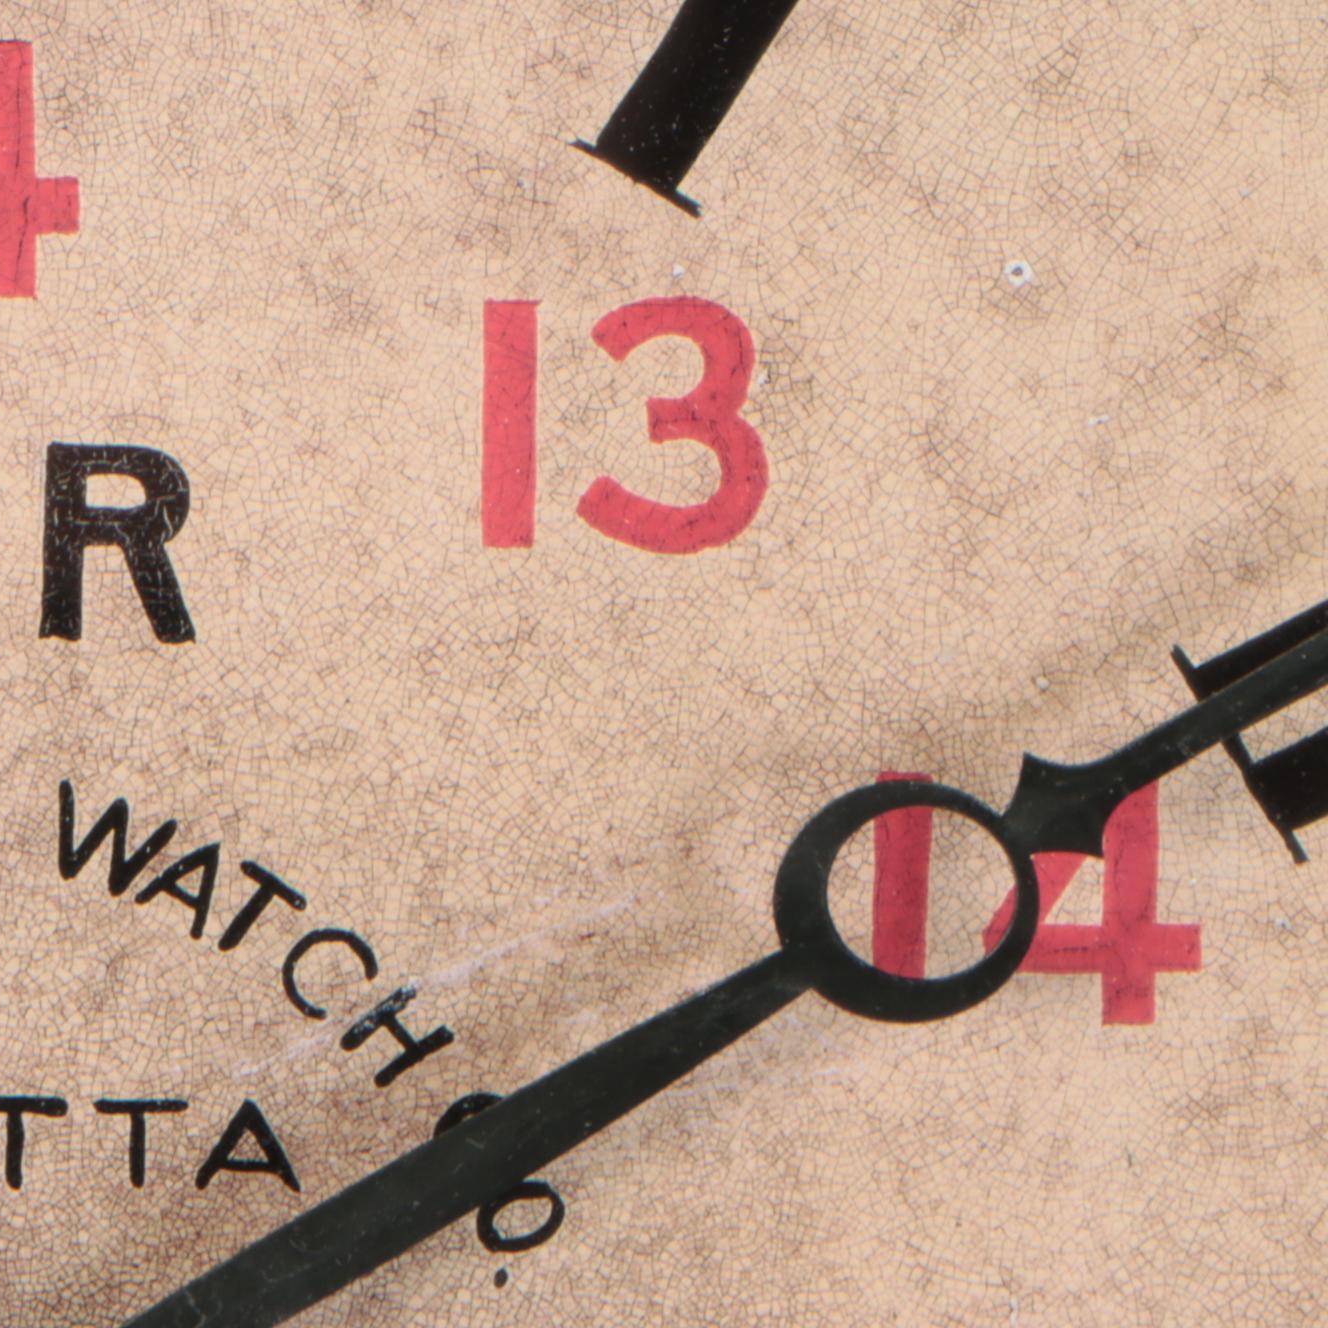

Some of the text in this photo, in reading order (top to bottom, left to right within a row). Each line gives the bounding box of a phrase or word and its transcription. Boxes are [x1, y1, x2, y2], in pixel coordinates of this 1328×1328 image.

[481, 294, 770, 555] 13
[58, 779, 456, 1088] WATCH
[870, 768, 1202, 1026] 14
